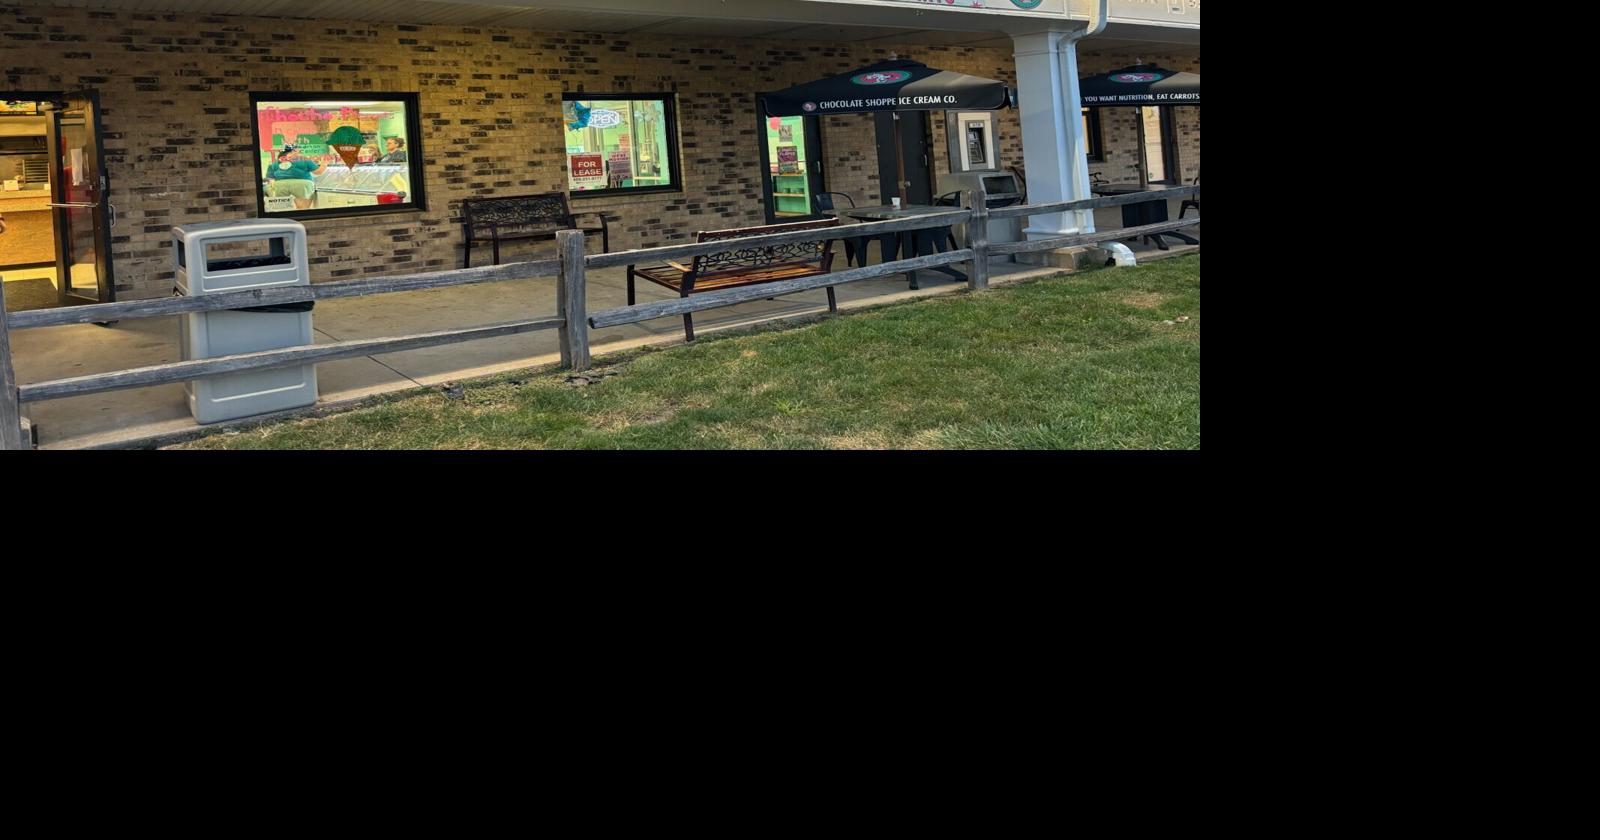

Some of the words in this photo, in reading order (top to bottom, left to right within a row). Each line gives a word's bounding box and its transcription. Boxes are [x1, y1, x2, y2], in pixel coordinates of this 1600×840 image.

[819, 99, 864, 109] CHOCOLATE
[865, 97, 897, 107] SHOPPE
[898, 96, 911, 105] ICE
[913, 95, 941, 104] CREAM
[943, 95, 957, 104] CO.
